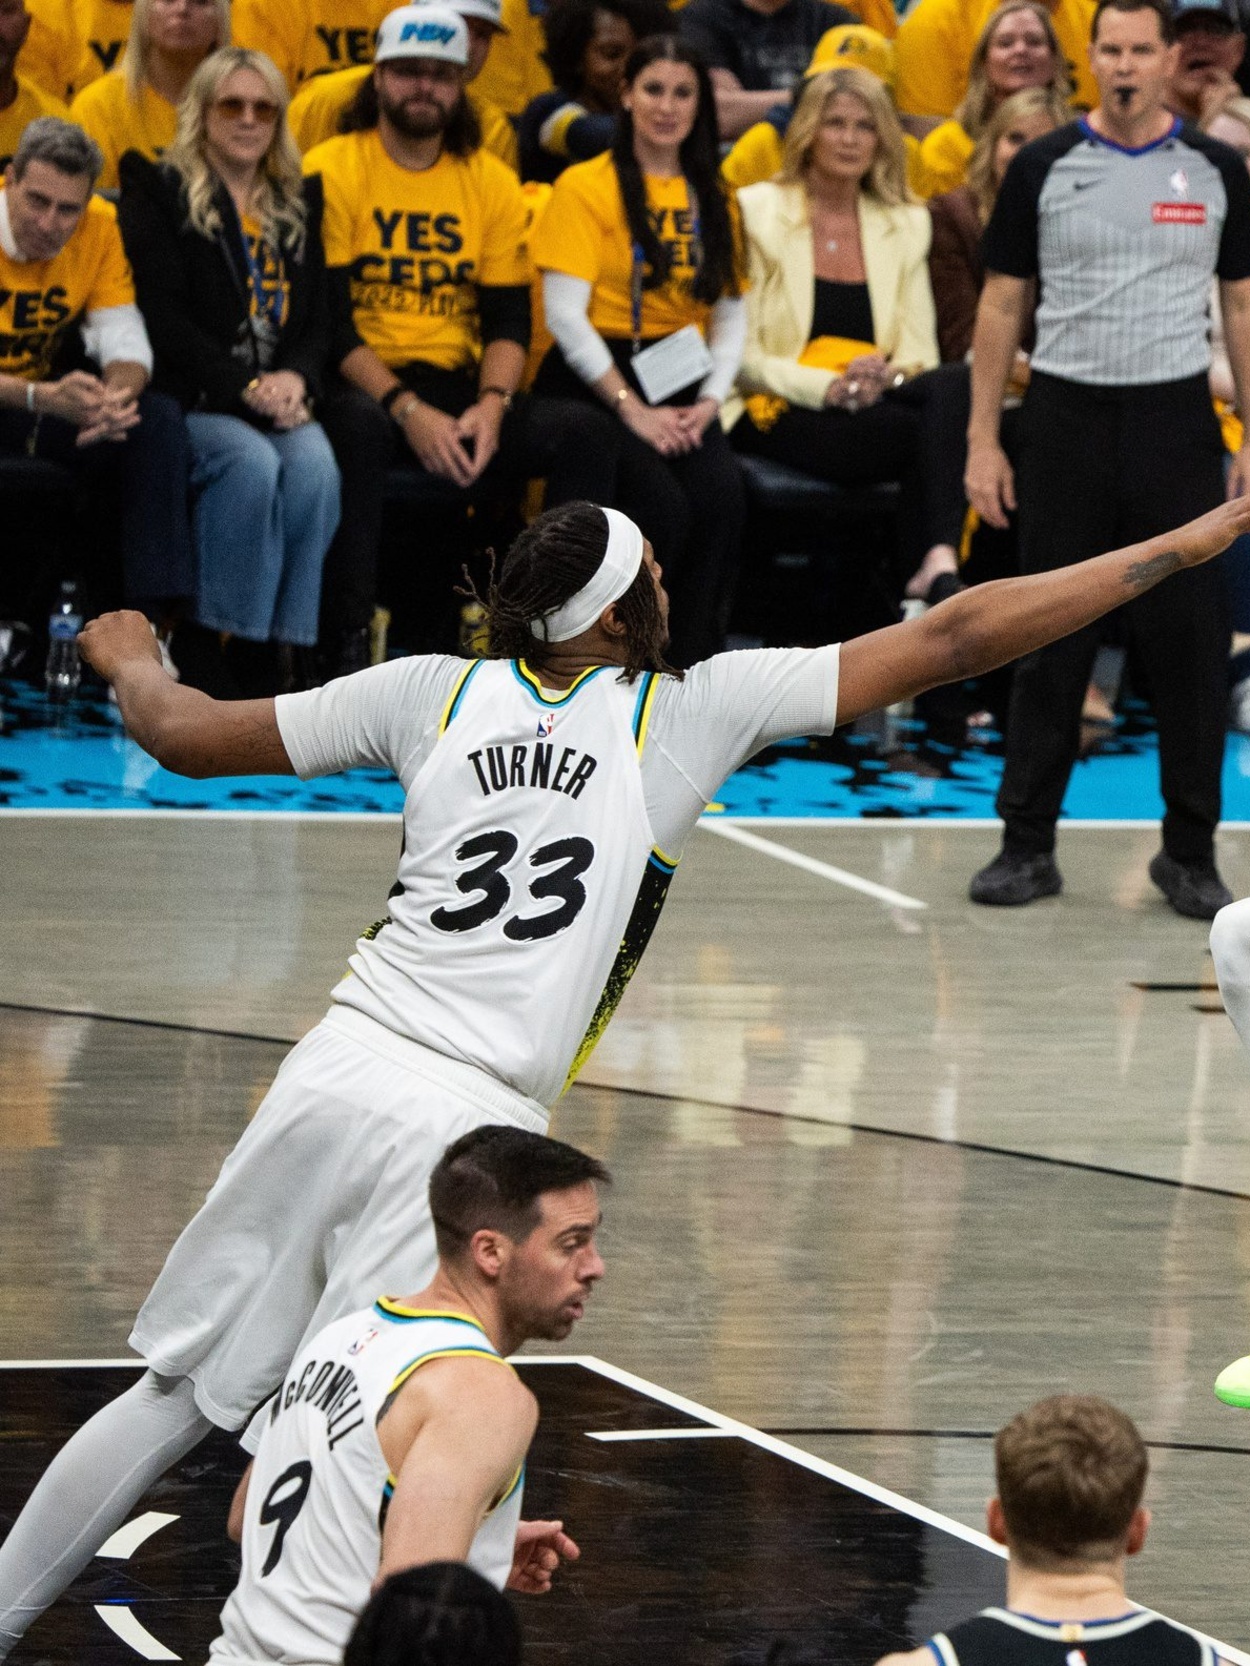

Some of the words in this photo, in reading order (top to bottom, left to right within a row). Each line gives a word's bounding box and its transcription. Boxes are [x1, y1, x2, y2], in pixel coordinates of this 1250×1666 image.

[315, 23, 382, 64] YE
[372, 206, 464, 255] YES
[466, 741, 598, 801] TURNER
[429, 829, 596, 943] 33
[259, 1459, 312, 1579] 9
